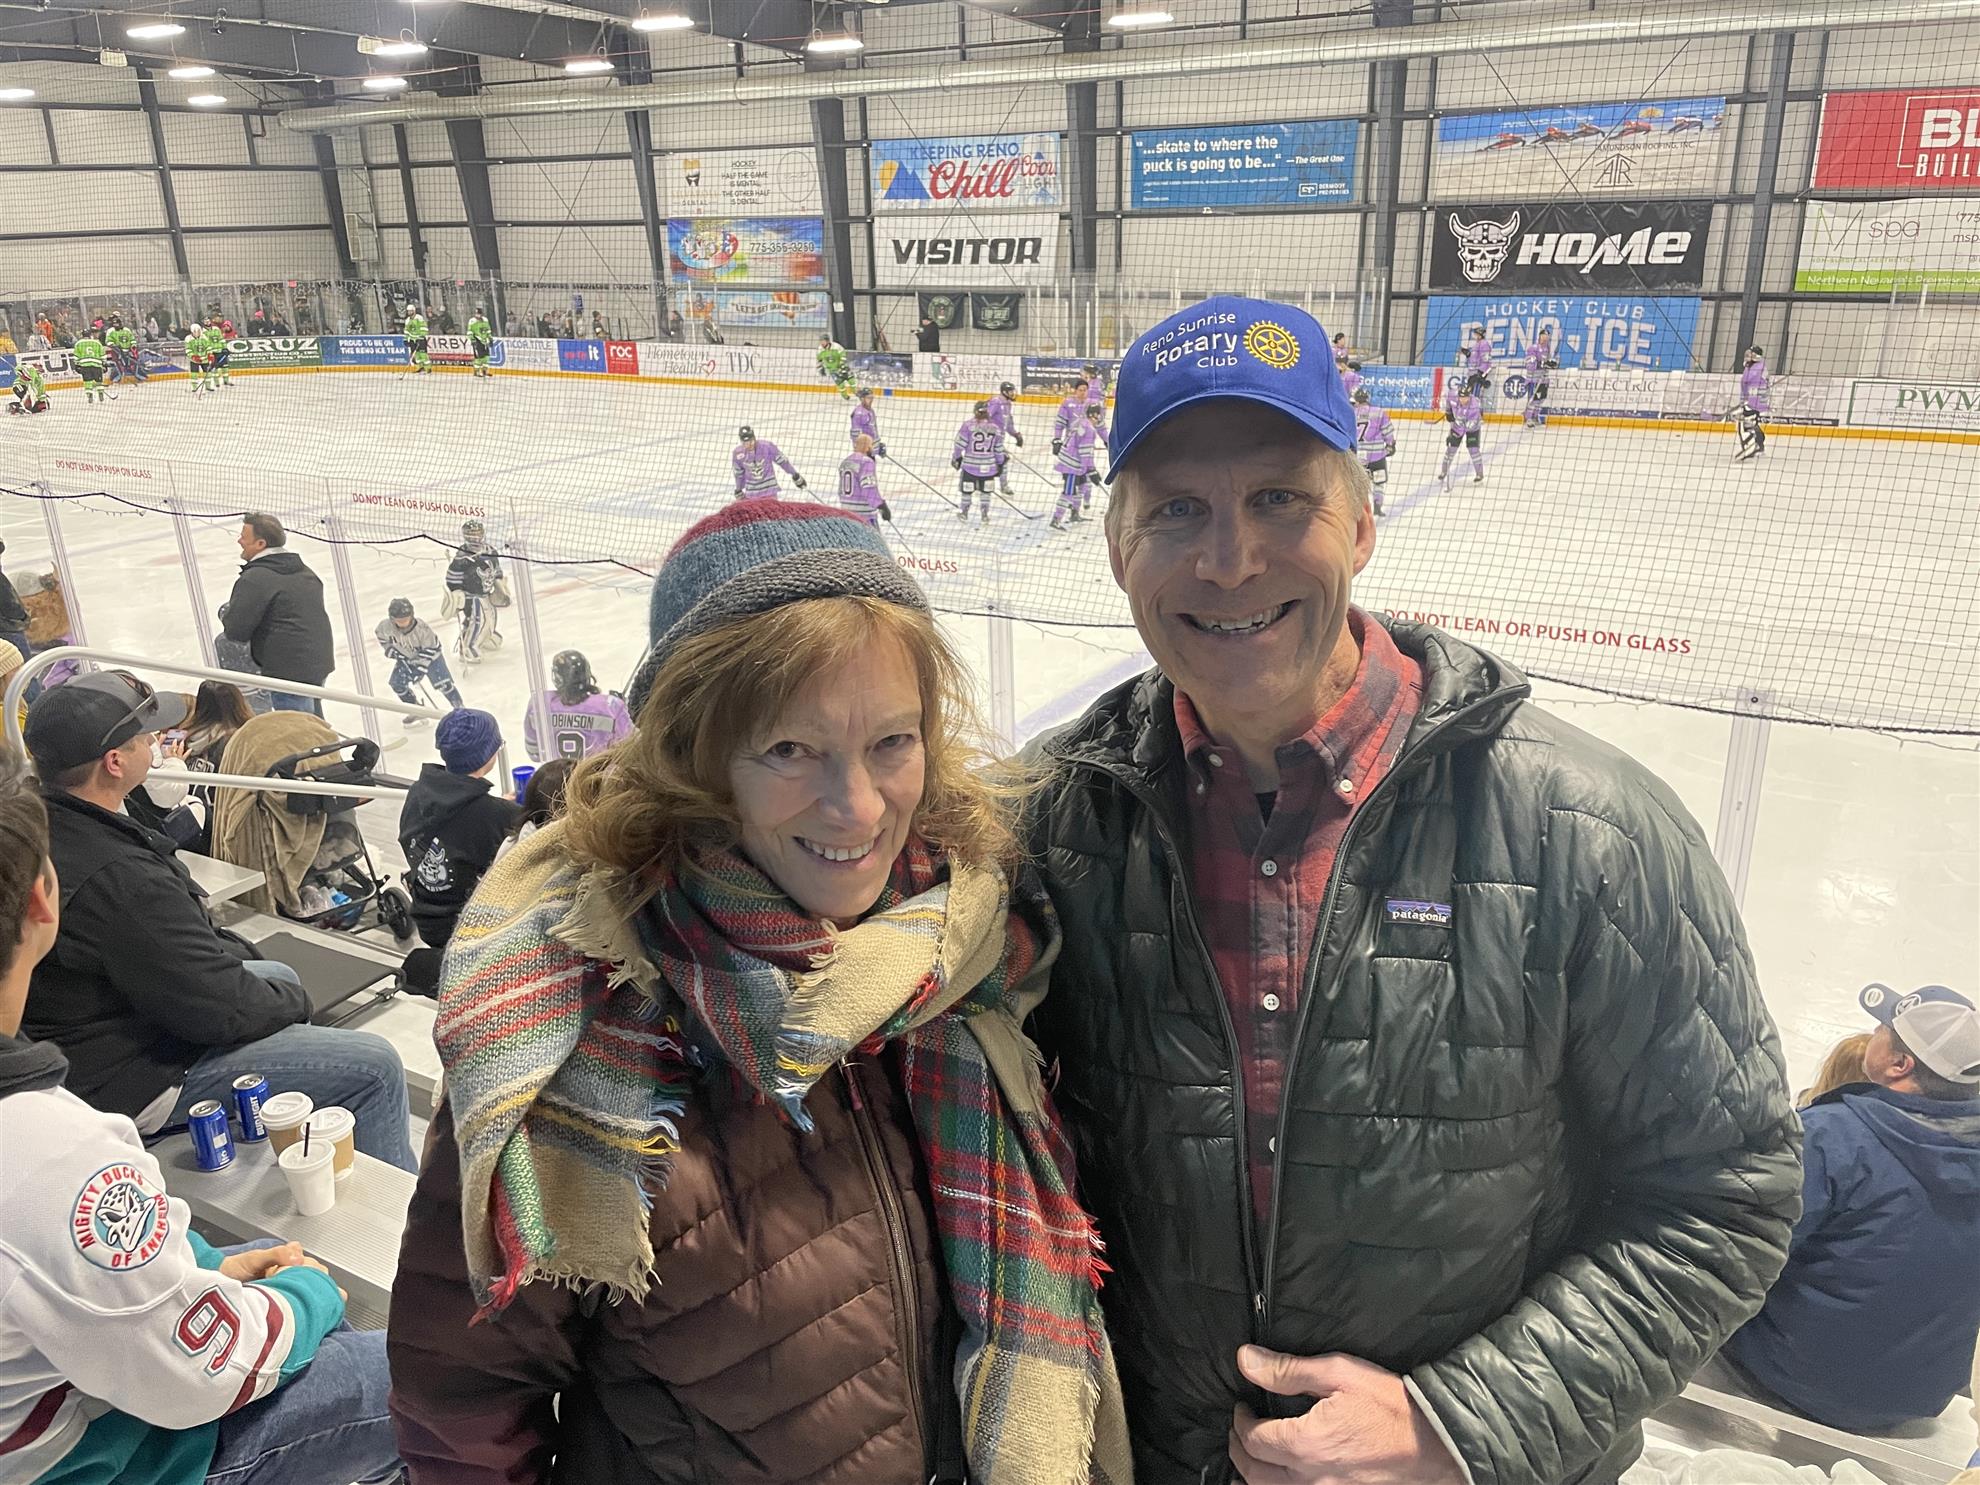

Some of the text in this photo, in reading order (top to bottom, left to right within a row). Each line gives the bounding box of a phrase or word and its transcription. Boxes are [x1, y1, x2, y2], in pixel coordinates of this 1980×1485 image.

[911, 142, 1020, 160] KEEPING RENO
[1194, 140, 1207, 153] to
[1210, 137, 1252, 151] where
[1255, 135, 1278, 149] the
[731, 160, 757, 168] HOCKEY
[1021, 154, 1057, 176] Coor
[1143, 158, 1172, 175] puck
[1176, 157, 1187, 171] is
[1190, 156, 1226, 174] going
[1228, 156, 1242, 170] to
[1310, 155, 1329, 164] Great
[1331, 155, 1345, 163] One
[1915, 153, 1980, 178] BUIL
[929, 159, 1018, 200] Chill
[1869, 221, 1920, 244] spa
[1952, 234, 1980, 243] msp
[892, 237, 1042, 265] VISITOR
[1485, 300, 1645, 320] HOCKEY CLUB
[339, 339, 394, 347] PROUD TO BE ON
[426, 338, 468, 350] KIRBY
[1142, 312, 1236, 357] Reno Sunrise
[1584, 317, 1655, 369] ICE
[227, 338, 319, 353] CRUZ
[387, 346, 406, 354] TEAM
[647, 345, 710, 361] Hometown
[1154, 331, 1238, 373] Rotary
[664, 360, 702, 375] Health
[726, 352, 762, 374] TDC
[1197, 354, 1238, 368] Club
[1377, 376, 1430, 388] checked?
[1549, 379, 1658, 392] ELIX ELECTRIC
[1895, 388, 1980, 411] PWM
[973, 431, 996, 453] 27
[56, 459, 152, 479] DO NOT LEAN OR PUSH ON GLASS
[352, 492, 486, 518] DO NOT LEAN OR PUSH ON GLASS
[898, 556, 958, 573] ON GLASS
[1413, 612, 1450, 628] NOT
[1454, 615, 1500, 634] LEAN
[1505, 620, 1531, 638] OR
[1535, 624, 1587, 643] PUSH
[1592, 630, 1621, 647] ON
[1626, 633, 1692, 655] GLASS
[551, 713, 594, 729] OBINSON
[1391, 910, 1448, 923] patagonia
[249, 1096, 265, 1136] BUD LIGHT
[75, 1166, 143, 1249] MIGHTY DUCKS
[111, 1194, 167, 1267] OF ANAHEIM
[171, 1284, 241, 1377] 9
